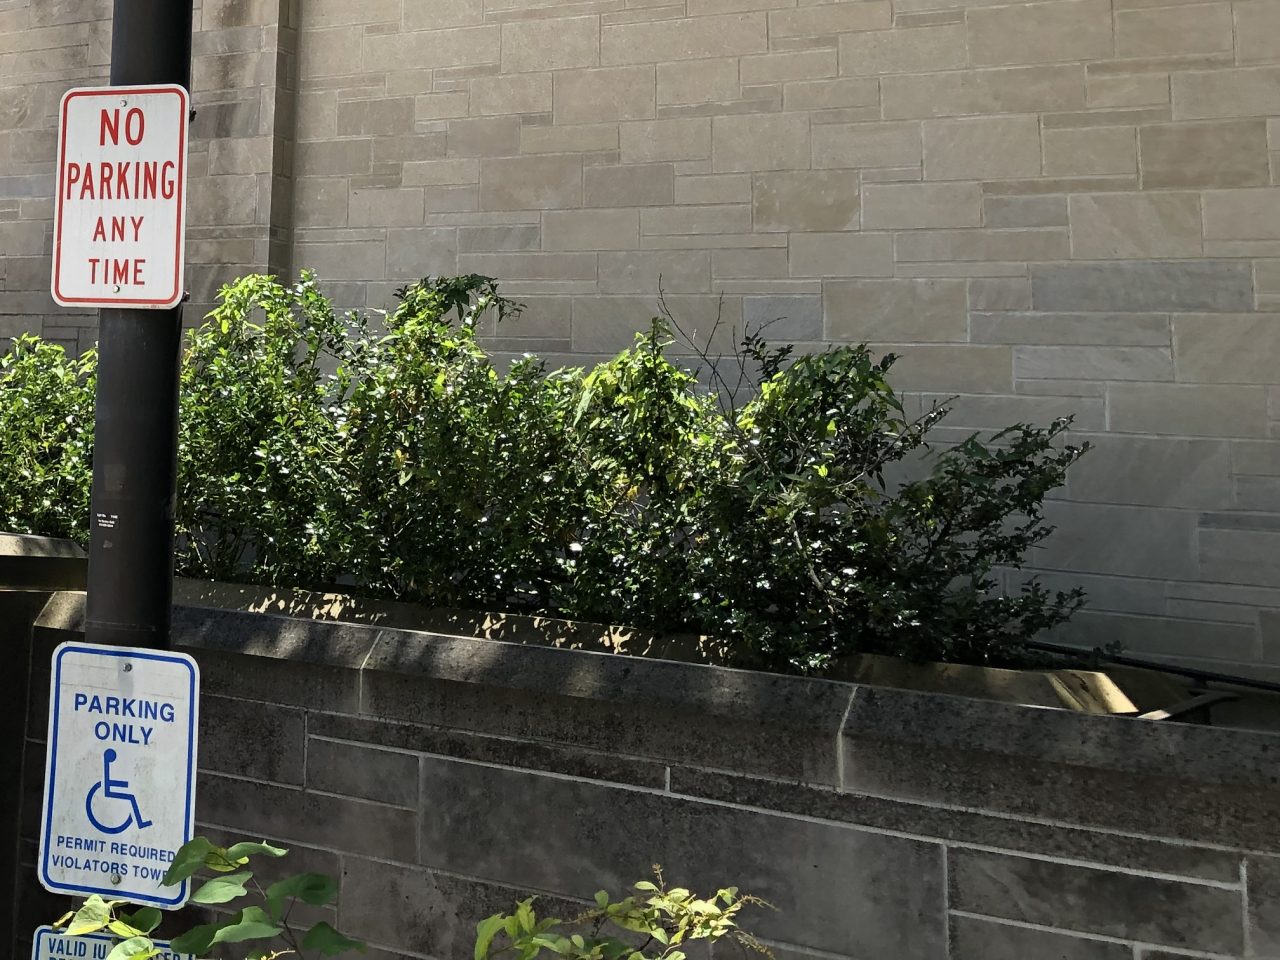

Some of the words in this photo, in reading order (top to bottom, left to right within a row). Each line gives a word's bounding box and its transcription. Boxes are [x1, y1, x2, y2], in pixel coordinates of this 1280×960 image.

[99, 107, 145, 146] NO
[66, 160, 175, 200] PARKING
[92, 216, 145, 242] ANY
[88, 258, 146, 286] TIME
[74, 692, 175, 723] PARKING
[94, 721, 154, 746] ONLY
[56, 835, 107, 853] PERMIT
[110, 842, 176, 863] REQUIRED
[52, 854, 128, 876] VIOLATORS
[48, 937, 87, 957] VALID
[93, 943, 107, 960] IU
